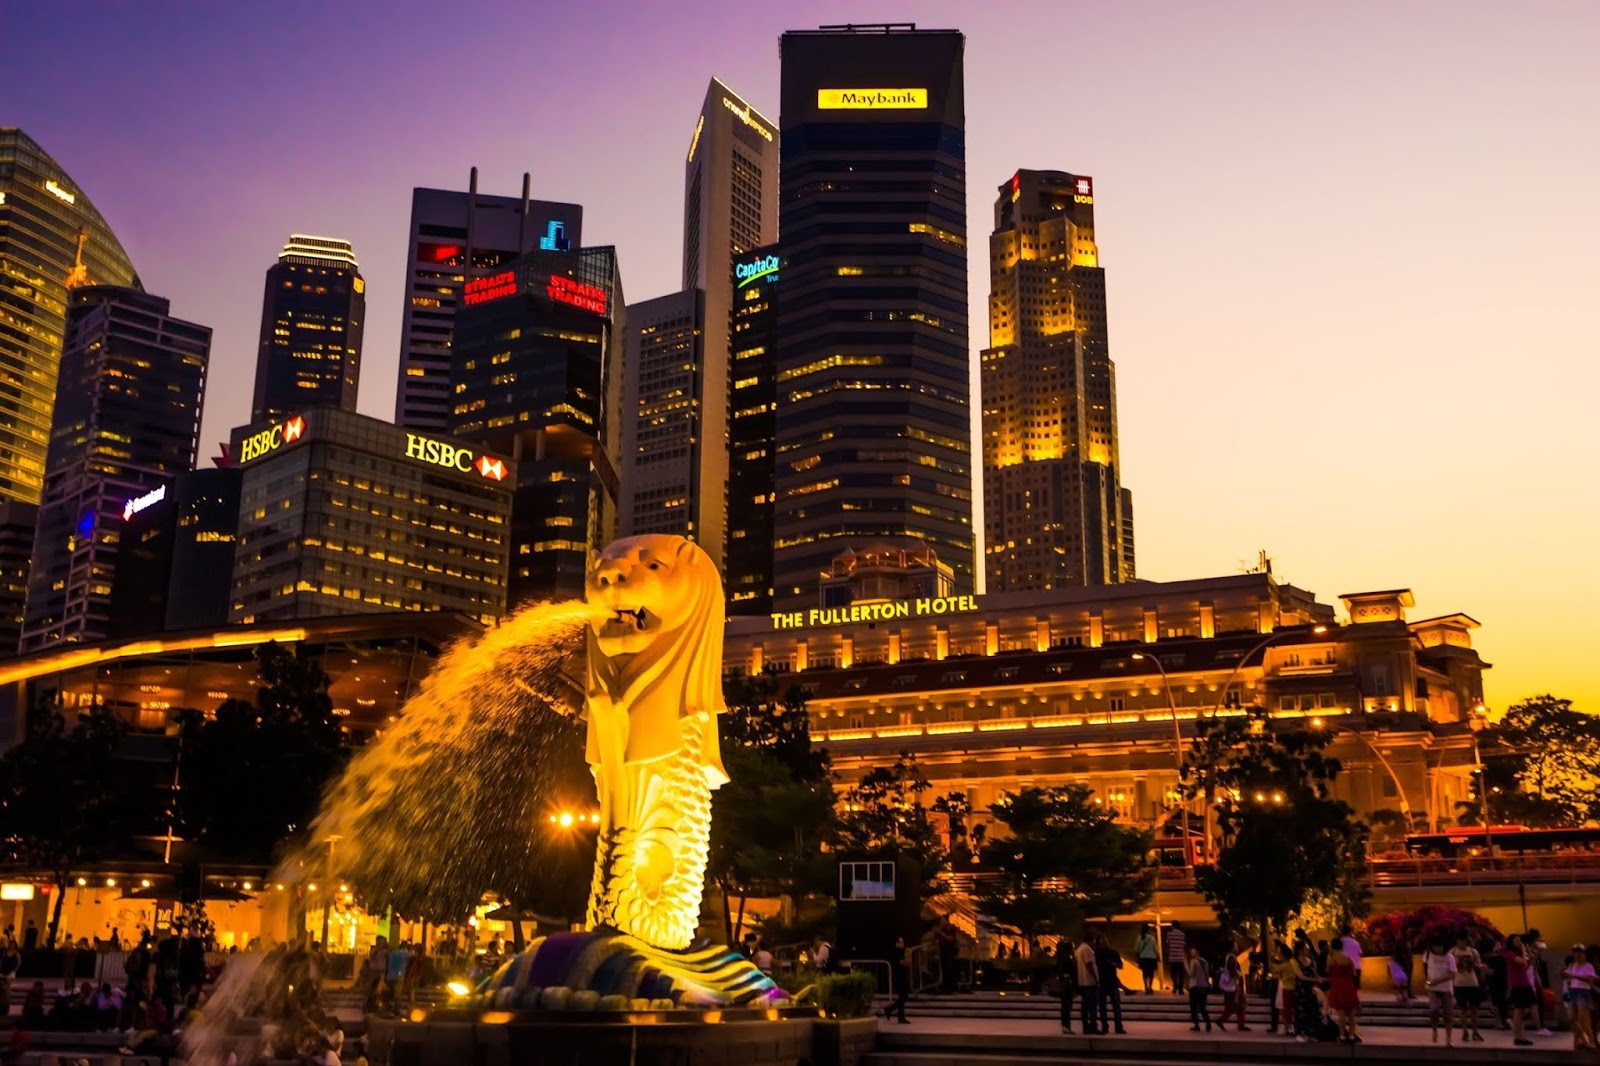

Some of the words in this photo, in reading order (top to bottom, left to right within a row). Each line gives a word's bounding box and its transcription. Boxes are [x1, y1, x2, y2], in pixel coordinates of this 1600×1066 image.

[841, 92, 916, 106] Maybank
[1073, 194, 1093, 205] UOB
[736, 255, 779, 278] CapitaCo
[464, 271, 515, 294] STRAITS
[464, 283, 517, 305] TRADING
[550, 274, 606, 302] STRAITS
[546, 285, 605, 315] TRADING
[240, 425, 282, 463] HSBC
[405, 433, 473, 472] HSBC
[771, 613, 803, 629] THE
[809, 602, 909, 626] FULLERTON
[916, 595, 978, 615] HOTEL
